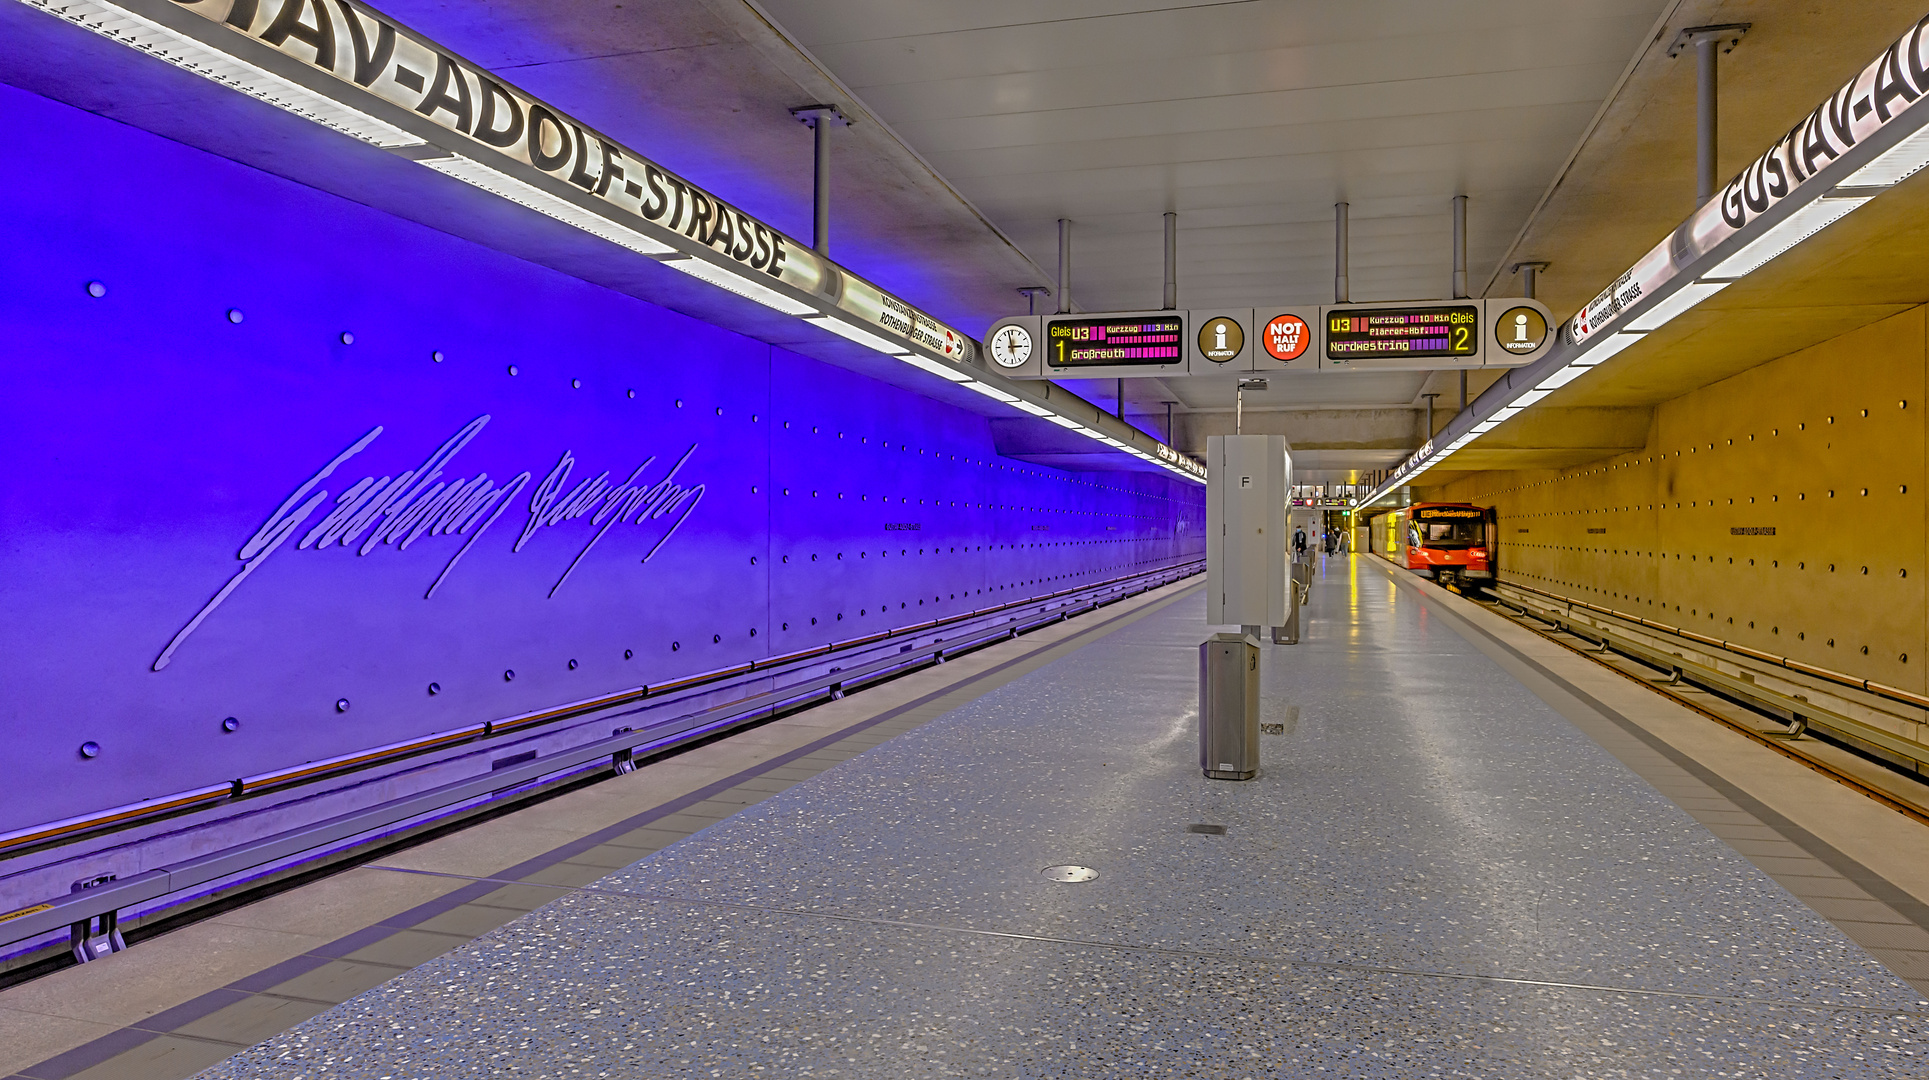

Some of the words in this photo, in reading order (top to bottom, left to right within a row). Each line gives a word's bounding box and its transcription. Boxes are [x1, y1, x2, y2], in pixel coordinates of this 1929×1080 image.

[168, 0, 788, 279] AV-ADOLF-STRASSE
[1621, 282, 1642, 304] STRASSE
[1369, 316, 1404, 325] Kurzzug
[1419, 315, 1429, 323] 10
[1434, 314, 1449, 322] Min
[1451, 313, 1474, 324] Gleis
[1106, 325, 1138, 334] Kurzzug
[1270, 322, 1302, 336] NOT
[1331, 318, 1350, 332] U3
[880, 312, 924, 343] ROTHENBURGER
[924, 333, 943, 351] STRASSE
[1051, 326, 1071, 337] Gleis
[1072, 327, 1089, 340] U3
[1273, 335, 1299, 344] HALT
[1455, 327, 1469, 350] 2
[1056, 340, 1064, 362] 1
[1277, 343, 1296, 353] RUF
[1330, 340, 1409, 352] Nordwestring
[1071, 348, 1125, 360] Großreuth
[1241, 476, 1250, 488] F
